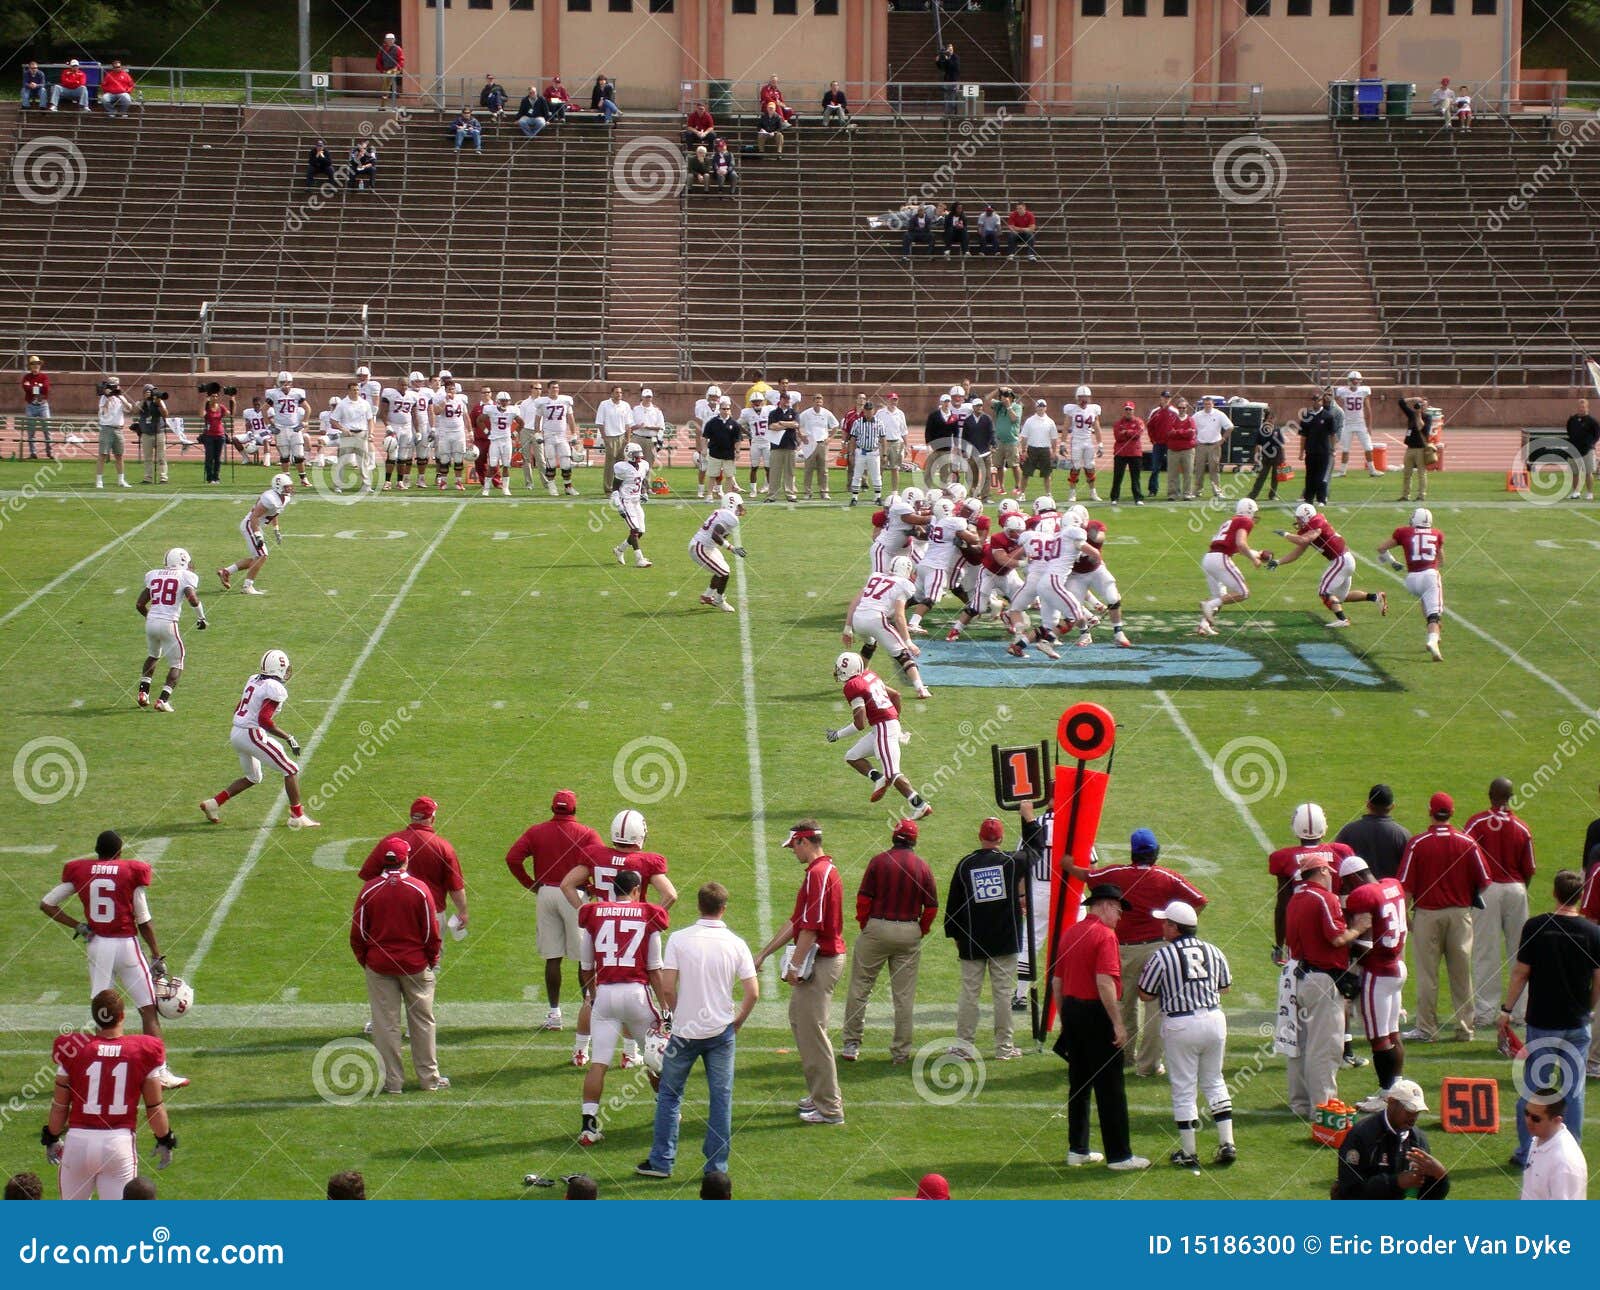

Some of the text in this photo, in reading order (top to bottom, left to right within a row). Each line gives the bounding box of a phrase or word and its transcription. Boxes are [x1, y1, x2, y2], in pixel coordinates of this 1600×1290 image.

[278, 399, 296, 414] 76
[392, 400, 411, 414] 73
[444, 404, 462, 418] 64
[1346, 396, 1362, 411] 56
[546, 404, 565, 421] 77
[1074, 413, 1093, 429] 94
[497, 416, 508, 430] 5
[752, 420, 768, 437] 15
[1410, 533, 1438, 561] 15
[150, 577, 179, 606] 28
[863, 576, 896, 600] 97
[1008, 751, 1034, 797] 1
[975, 876, 1002, 888] PAC
[89, 878, 116, 923] 6
[976, 885, 1003, 899] 10
[594, 919, 647, 968] 47
[1182, 946, 1209, 979] R
[82, 1061, 128, 1115] 11
[1447, 1083, 1495, 1127] 50
